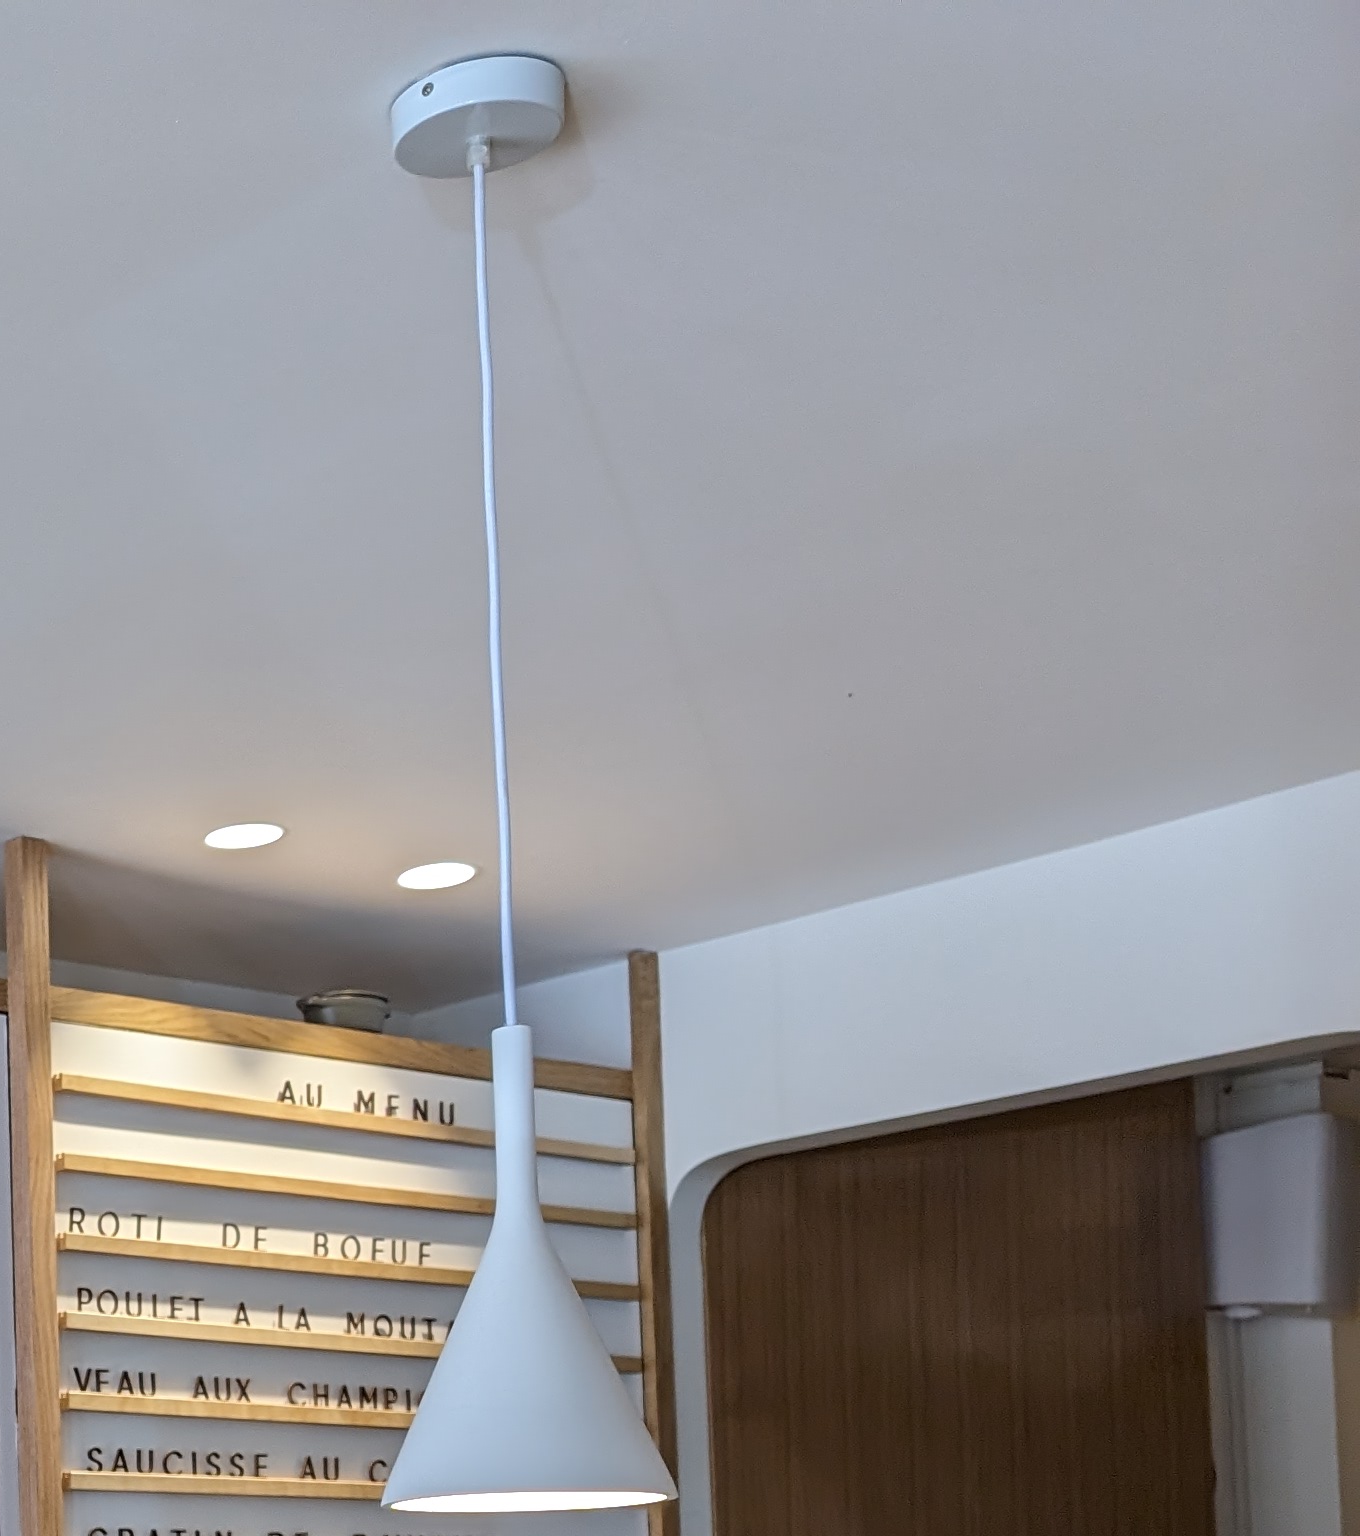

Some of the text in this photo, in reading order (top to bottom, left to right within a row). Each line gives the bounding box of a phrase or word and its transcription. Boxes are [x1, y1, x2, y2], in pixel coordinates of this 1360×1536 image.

[278, 1080, 458, 1127] AU MENU
[68, 1207, 433, 1267] ROTI DE BOEUF
[76, 1287, 454, 1342] POULET A LA MOUT
[74, 1367, 423, 1413] VEAU AUX CHAMPI
[86, 1447, 270, 1479] SAUCISSE
[299, 1457, 341, 1483] AU
